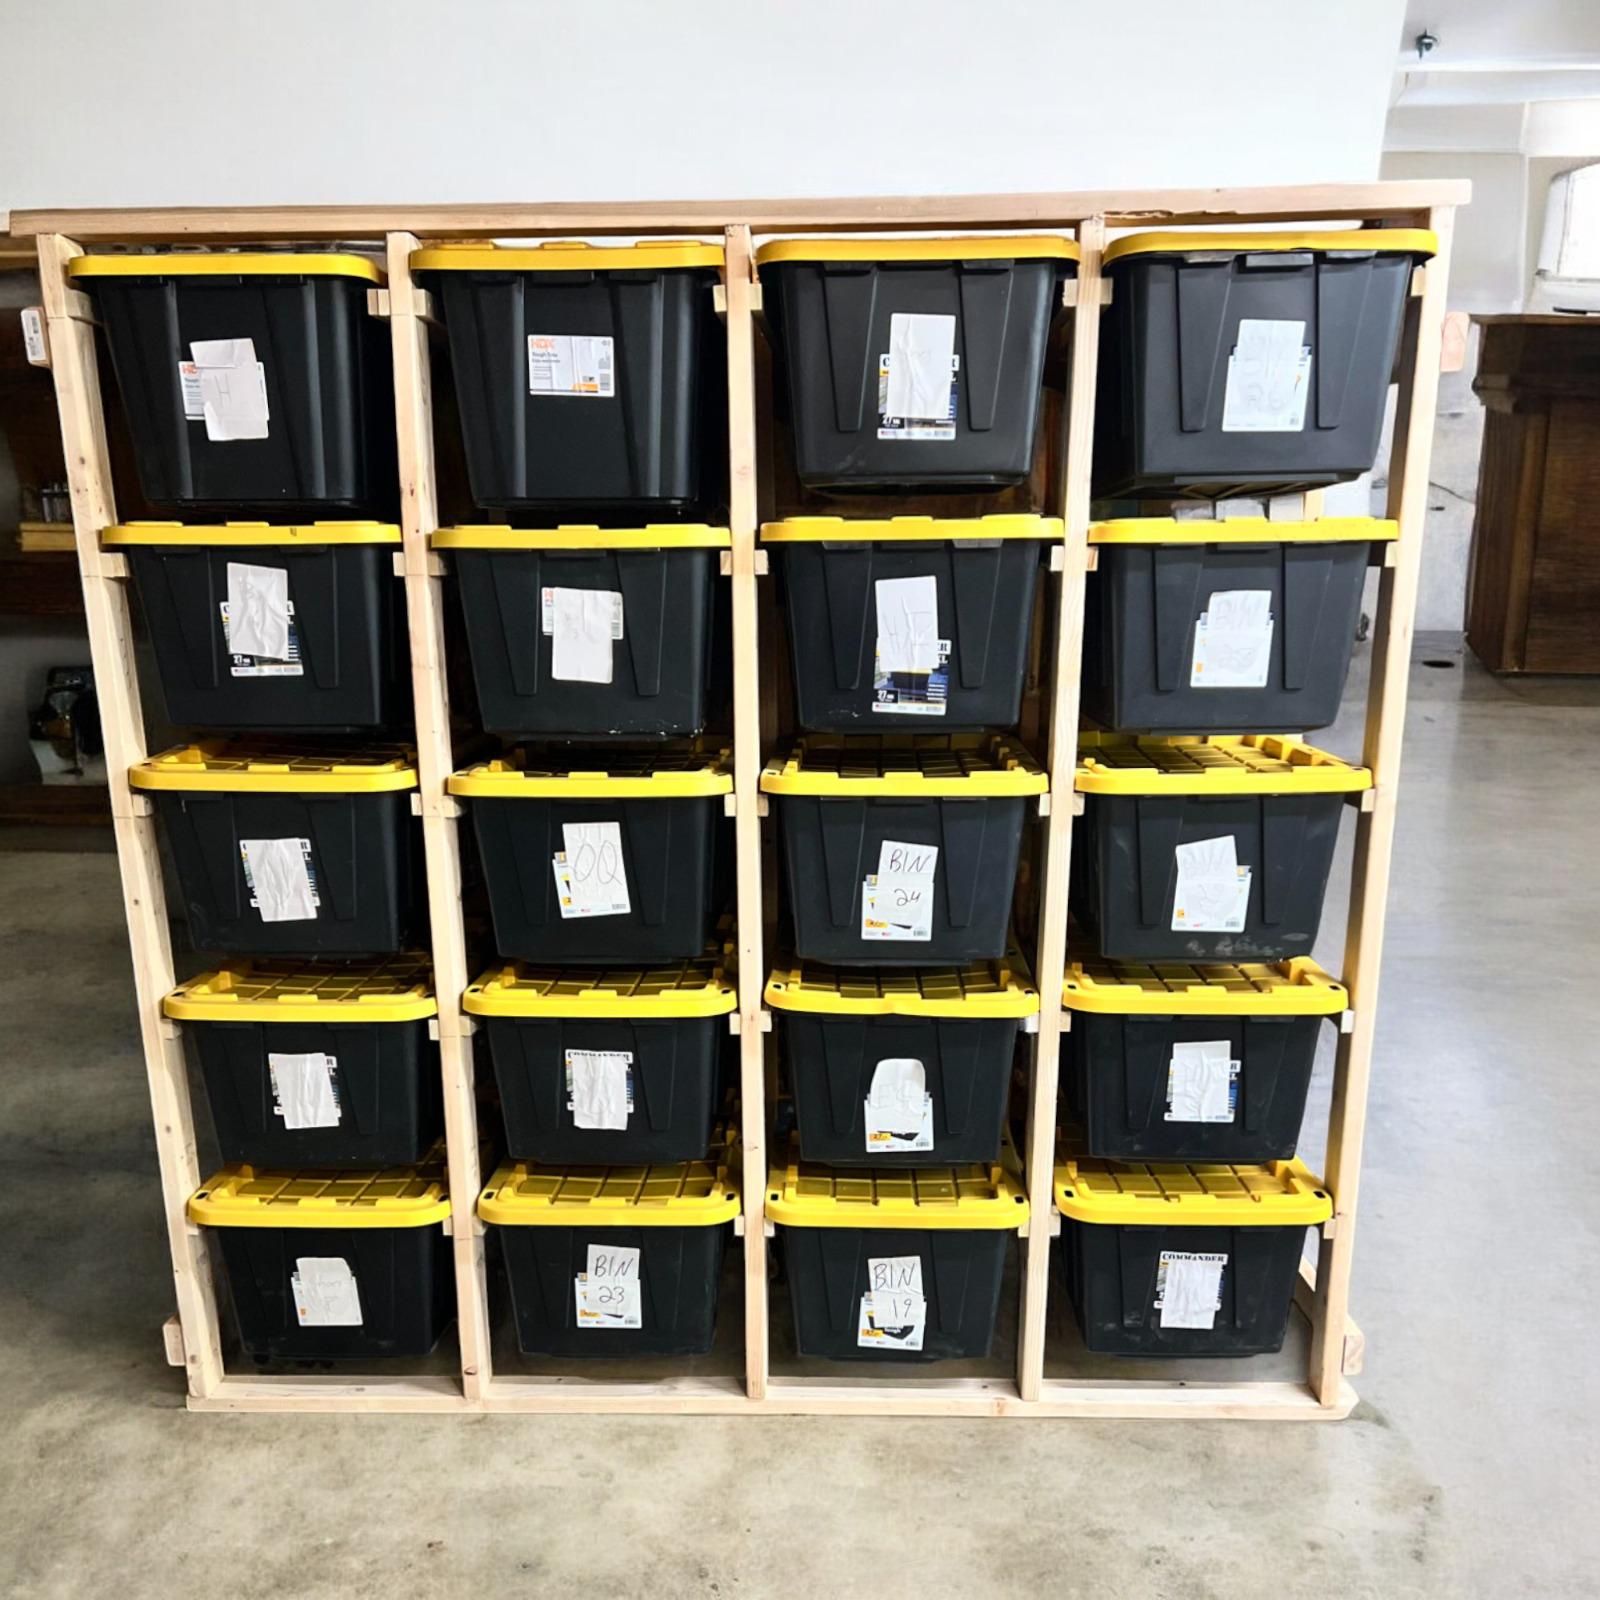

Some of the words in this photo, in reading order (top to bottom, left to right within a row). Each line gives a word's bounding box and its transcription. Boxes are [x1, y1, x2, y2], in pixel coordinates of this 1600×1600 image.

[889, 848, 932, 873] BIN
[894, 888, 921, 907] 24
[594, 1254, 634, 1278] BIN
[1162, 1252, 1225, 1262] COMMANDER
[873, 1262, 916, 1291] BIN
[598, 1285, 625, 1305] 23
[892, 1298, 912, 1319] 19
